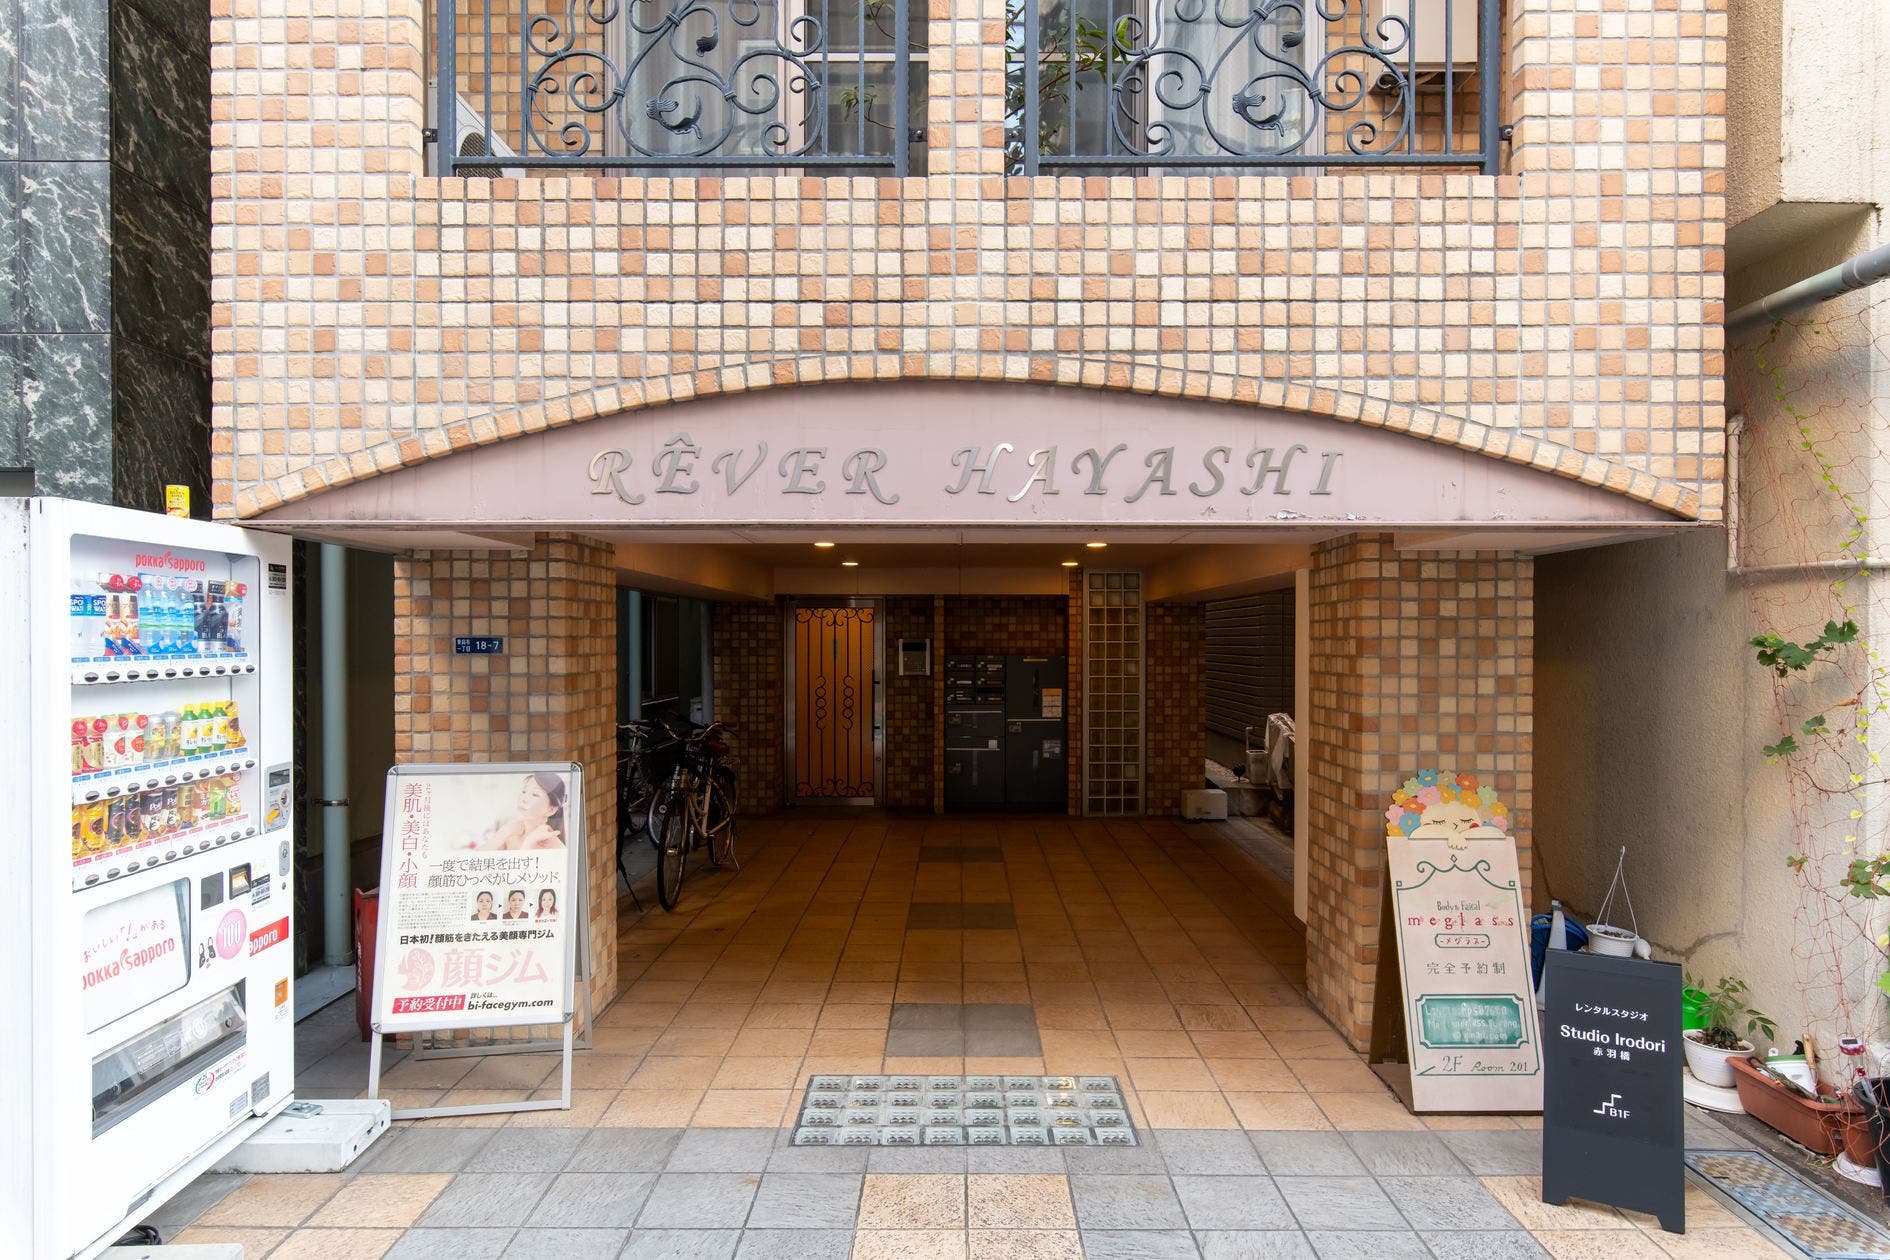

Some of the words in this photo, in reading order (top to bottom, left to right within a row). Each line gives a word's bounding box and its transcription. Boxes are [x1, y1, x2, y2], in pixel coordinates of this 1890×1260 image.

[588, 432, 899, 504] RÊVER
[944, 442, 1344, 503] HAYASHI
[475, 641, 499, 650] 18-7
[398, 783, 422, 888] 美肌・美白・小顔
[430, 856, 539, 872] 一度で結果を出す!
[223, 920, 241, 950] 100
[400, 930, 554, 945] 日本初!顔筋をきたえる美顔専門ジム
[440, 948, 548, 988] 顔ジム
[1427, 962, 1505, 975] 完全予約制
[399, 995, 463, 1012] 予約受付中
[468, 999, 554, 1011] bi-facegym.com
[1575, 1003, 1649, 1021] レンタルスタジオ
[1560, 1024, 1610, 1044] Studio
[1615, 1032, 1666, 1053] Irodori
[1593, 1046, 1631, 1061] 赤羽橋
[1442, 1055, 1463, 1072] 2F
[1470, 1061, 1504, 1072] Room
[1510, 1061, 1528, 1072] 201
[1609, 1108, 1631, 1119] B1F
